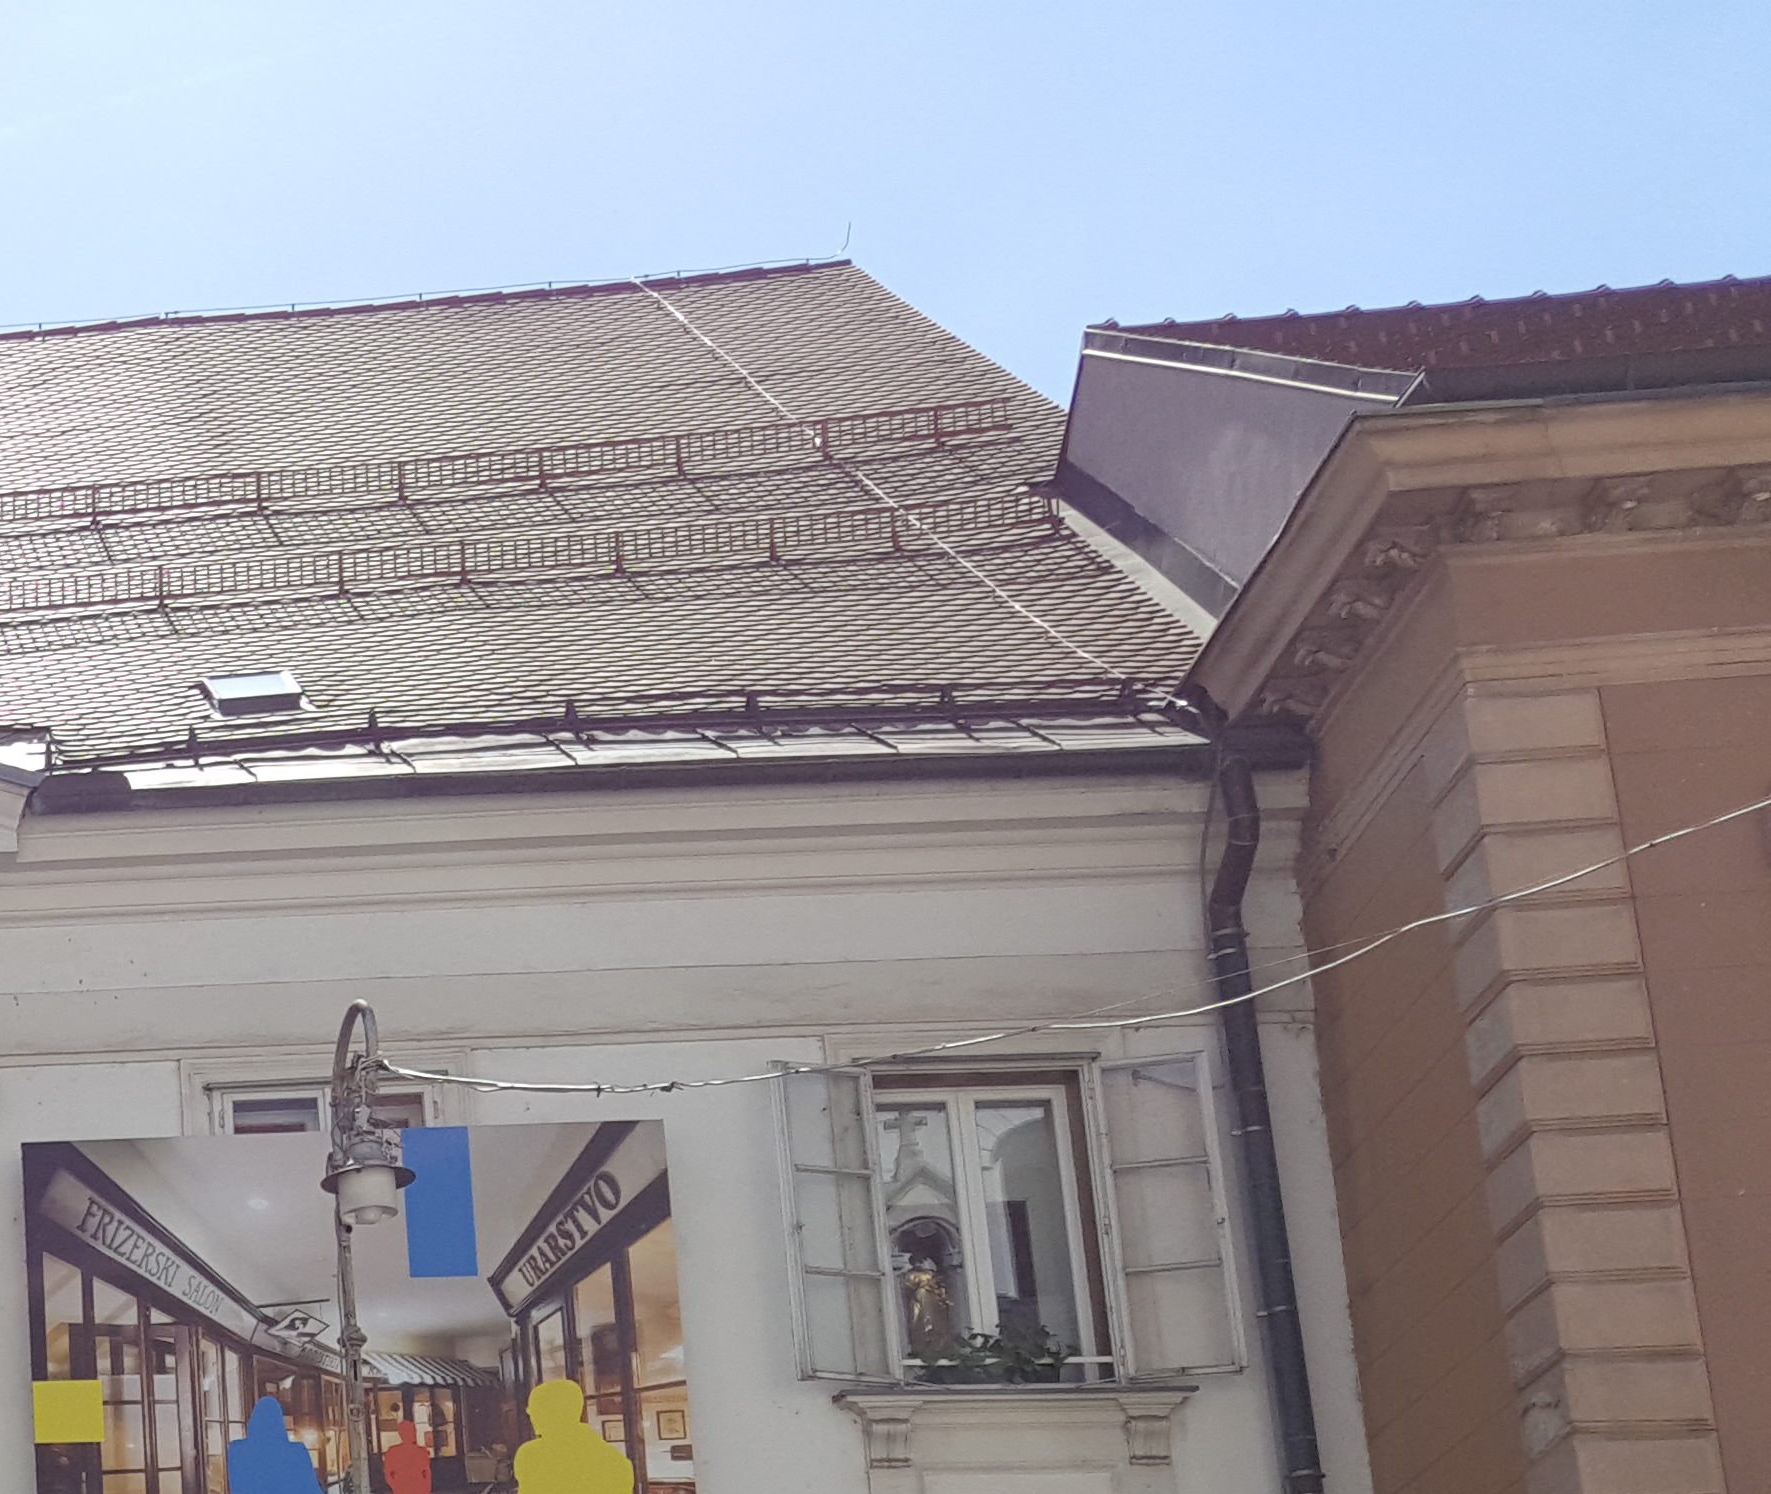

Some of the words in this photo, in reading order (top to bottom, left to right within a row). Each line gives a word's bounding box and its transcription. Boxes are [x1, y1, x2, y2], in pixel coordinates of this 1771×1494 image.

[76, 1196, 181, 1288] FRIZERSKI
[182, 1274, 225, 1317] SALON
[518, 1170, 621, 1287] URARSTVO
